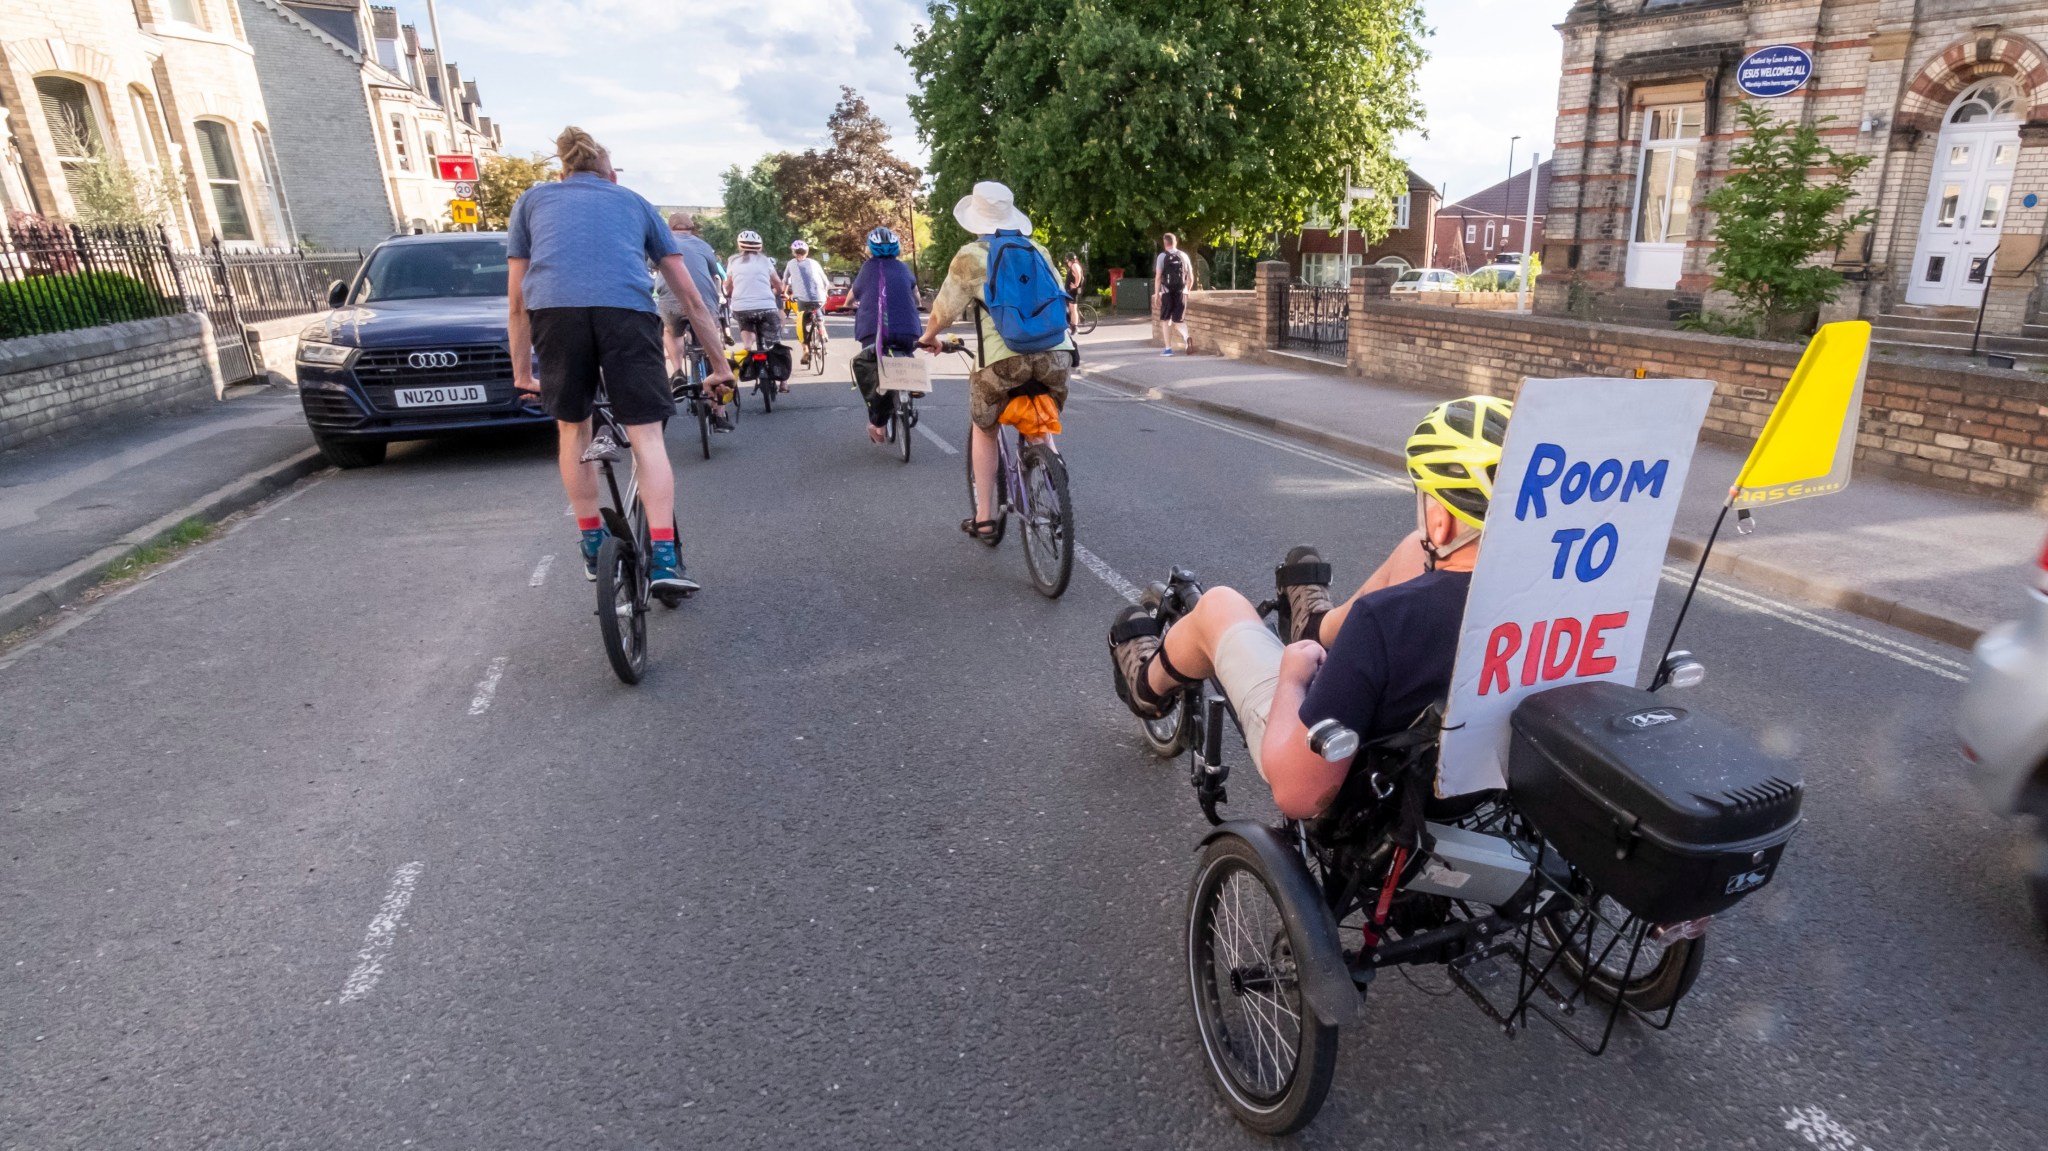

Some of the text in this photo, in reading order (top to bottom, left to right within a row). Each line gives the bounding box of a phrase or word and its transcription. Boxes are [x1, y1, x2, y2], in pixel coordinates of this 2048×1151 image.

[1766, 57, 1772, 65] by
[1772, 54, 1783, 63] Love
[1742, 65, 1805, 80] JESUS WELCOMES ALL
[403, 387, 478, 404] NU20 UJD
[1515, 442, 1669, 521] ROOM
[1804, 482, 1840, 494] BIKES
[1551, 521, 1619, 583] TO
[1478, 610, 1629, 696] RIDE
